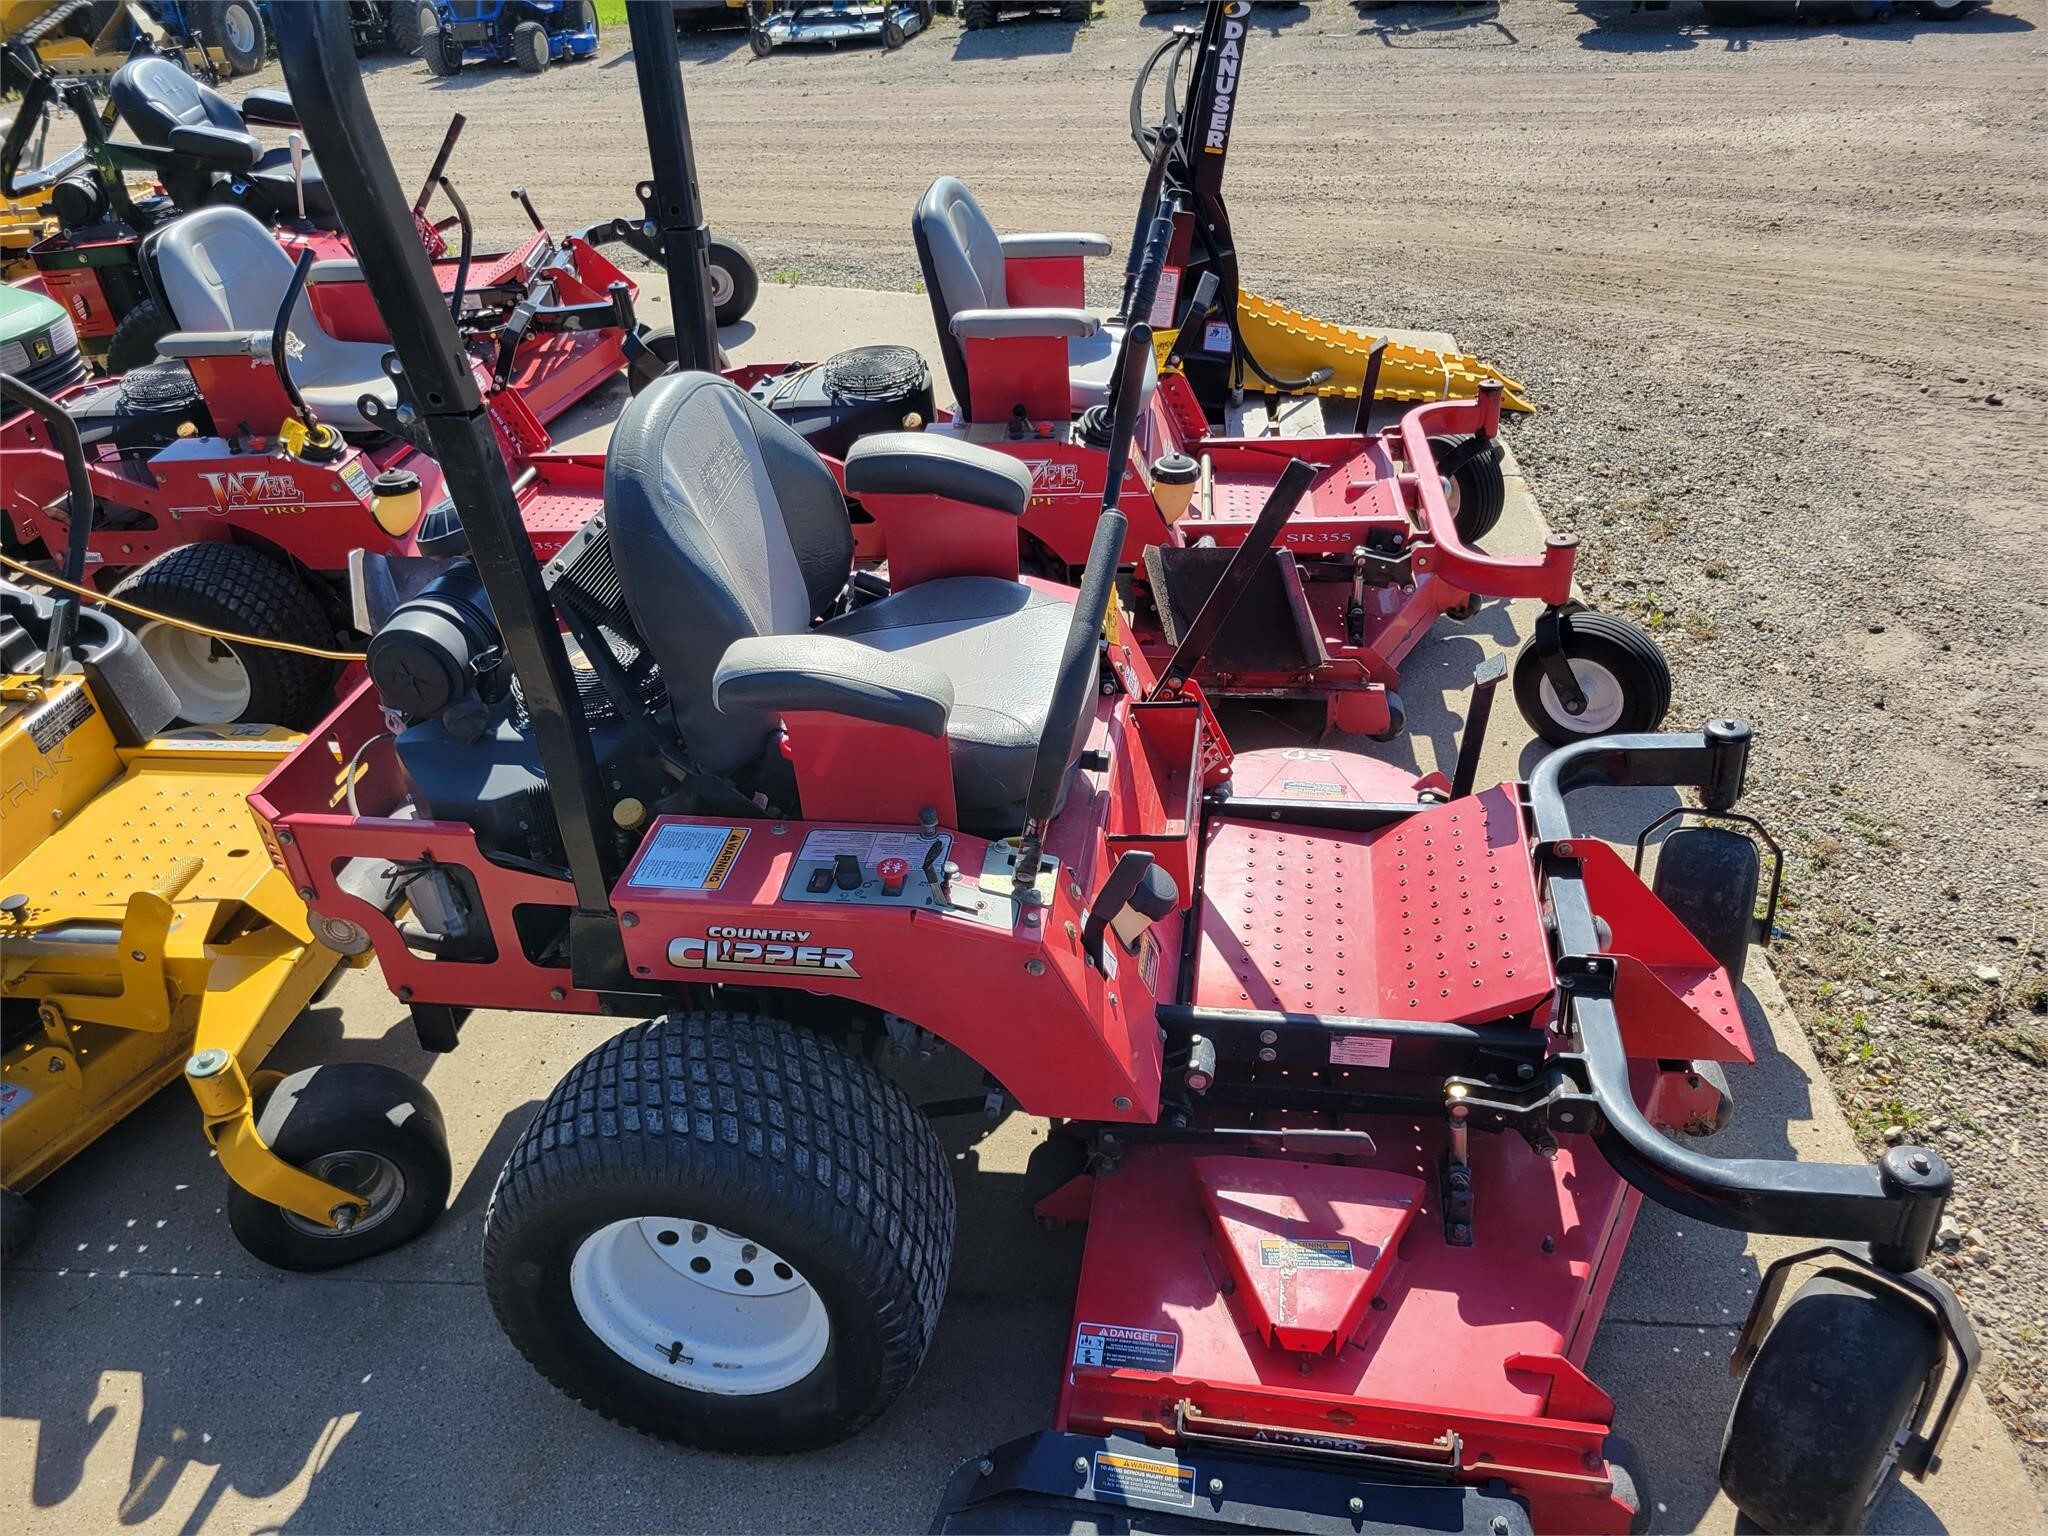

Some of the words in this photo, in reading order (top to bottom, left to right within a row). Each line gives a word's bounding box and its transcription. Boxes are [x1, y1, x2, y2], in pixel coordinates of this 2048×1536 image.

[1205, 21, 1244, 149] DANUSER
[263, 504, 306, 516] PRO
[1286, 533, 1315, 542] SR
[1317, 532, 1352, 542] 355
[709, 842, 739, 883] WARNING
[708, 926, 812, 942] COUNTRY
[667, 937, 863, 979] CLIPPER
[1110, 1328, 1158, 1342] DANGER
[1130, 1461, 1168, 1474] WARNING
